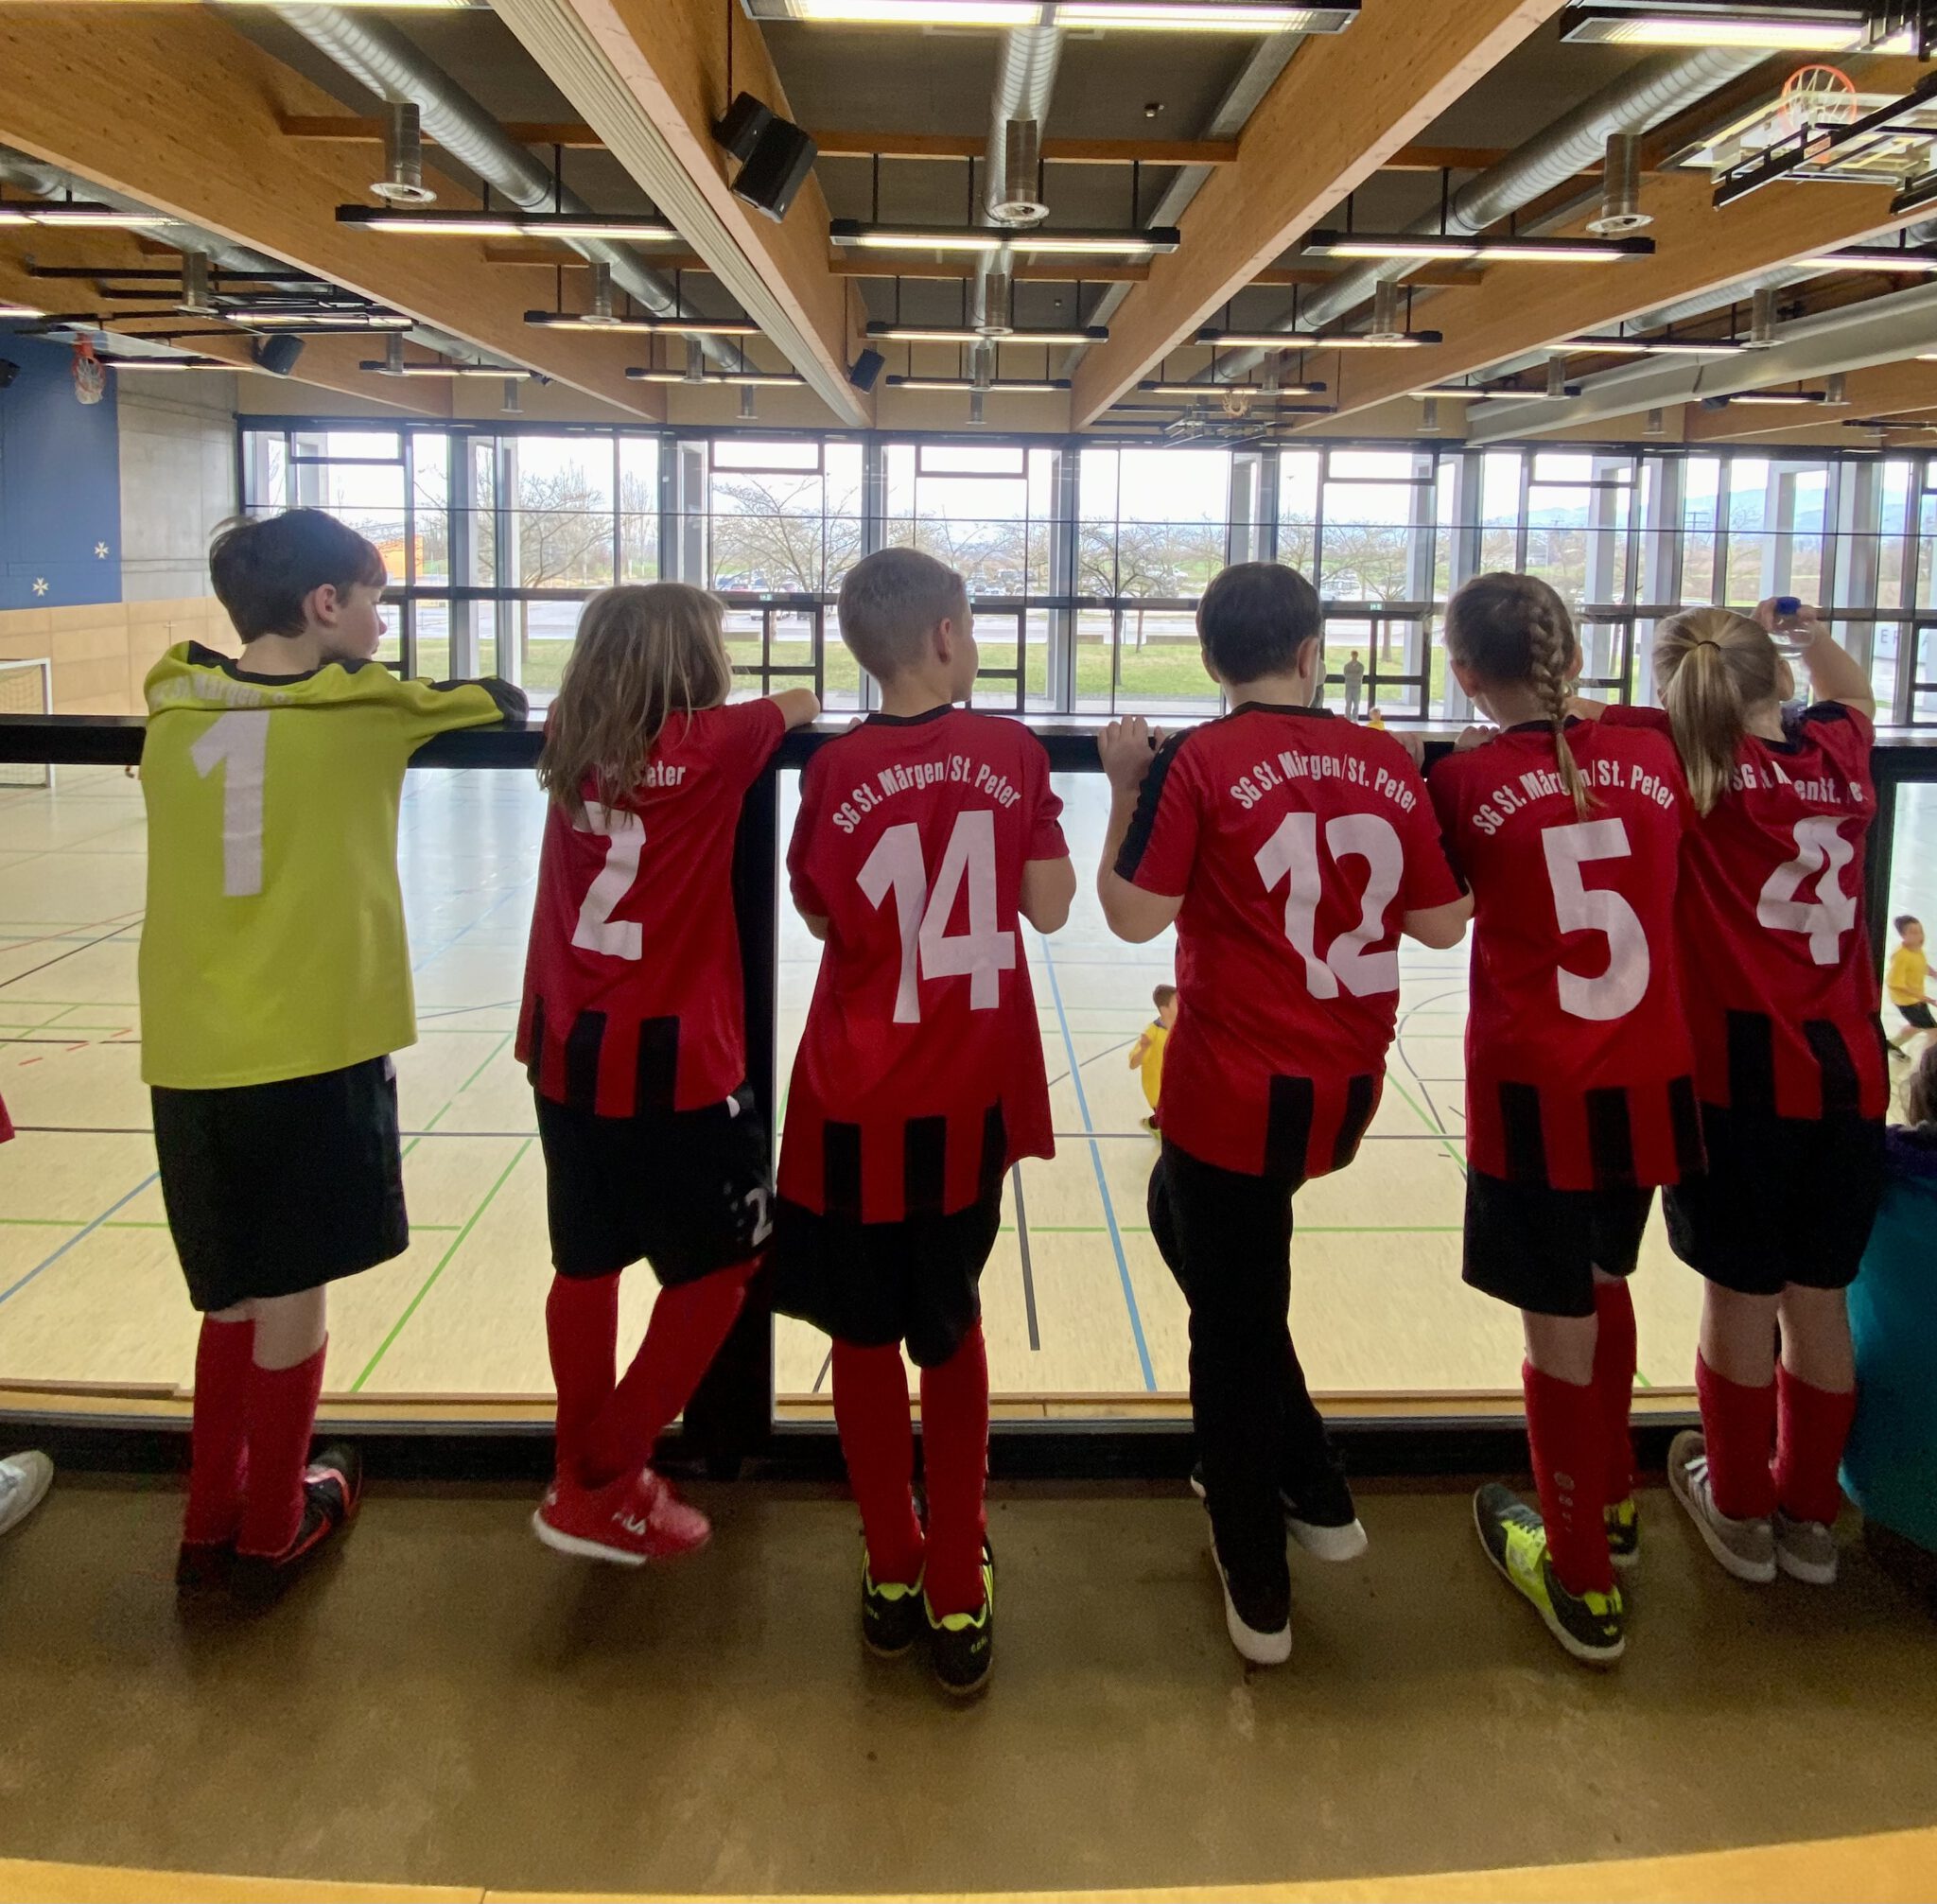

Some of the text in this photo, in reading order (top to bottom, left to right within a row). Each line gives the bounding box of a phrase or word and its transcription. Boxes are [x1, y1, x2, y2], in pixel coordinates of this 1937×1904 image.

[190, 710, 270, 897] 1
[642, 760, 687, 788] eter
[832, 802, 862, 834] SG
[852, 782, 883, 812] St.
[974, 763, 1021, 809] Peter
[1230, 777, 1263, 810] SG
[1252, 760, 1283, 791] St.
[1472, 804, 1505, 836] SG
[1492, 784, 1527, 814] St.
[1630, 764, 1675, 810] Peter
[570, 800, 646, 961] 2
[856, 810, 1017, 1023] 14
[1254, 812, 1404, 1000] 12
[1541, 817, 1650, 1022] 5
[1756, 814, 1857, 966] 4
[744, 1187, 774, 1248] 2
